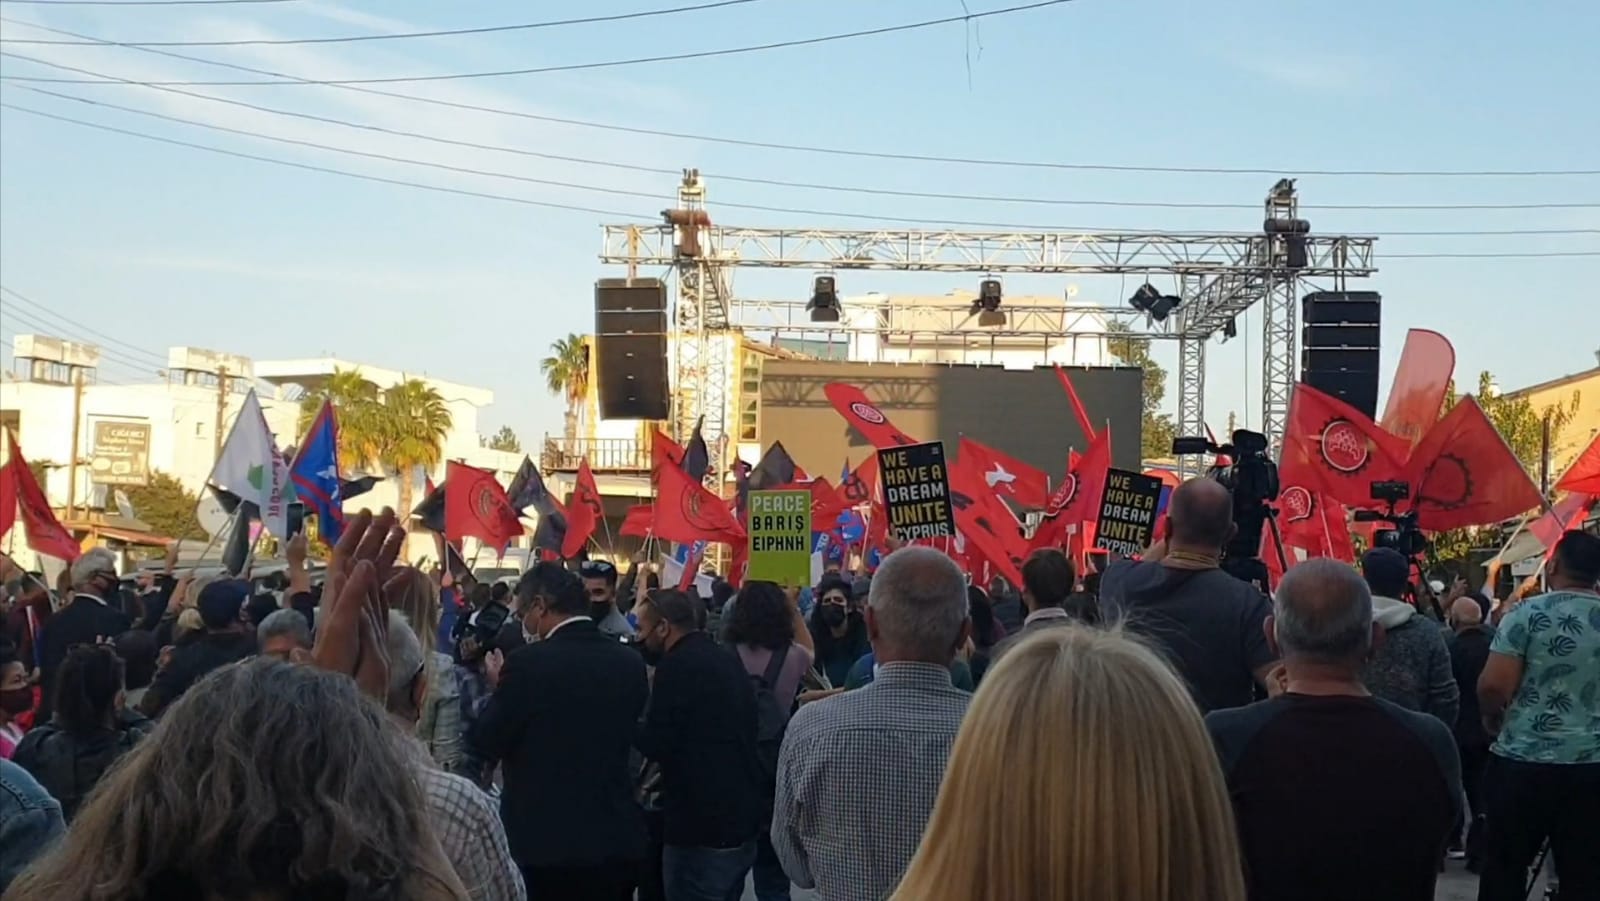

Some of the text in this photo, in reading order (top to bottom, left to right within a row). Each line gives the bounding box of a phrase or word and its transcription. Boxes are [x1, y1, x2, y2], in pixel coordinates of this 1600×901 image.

[883, 452, 907, 467] WE
[886, 464, 942, 484] HAVE A
[1111, 475, 1130, 489] WE
[887, 482, 944, 503] DREAM
[1107, 490, 1153, 509] HAVE A
[752, 495, 804, 513] PEACE
[892, 502, 946, 525] UNITE
[1104, 504, 1150, 523] DREAM
[752, 515, 804, 533] BARIŞ
[895, 522, 949, 541] CYPRUS
[1100, 519, 1147, 542] UNITE
